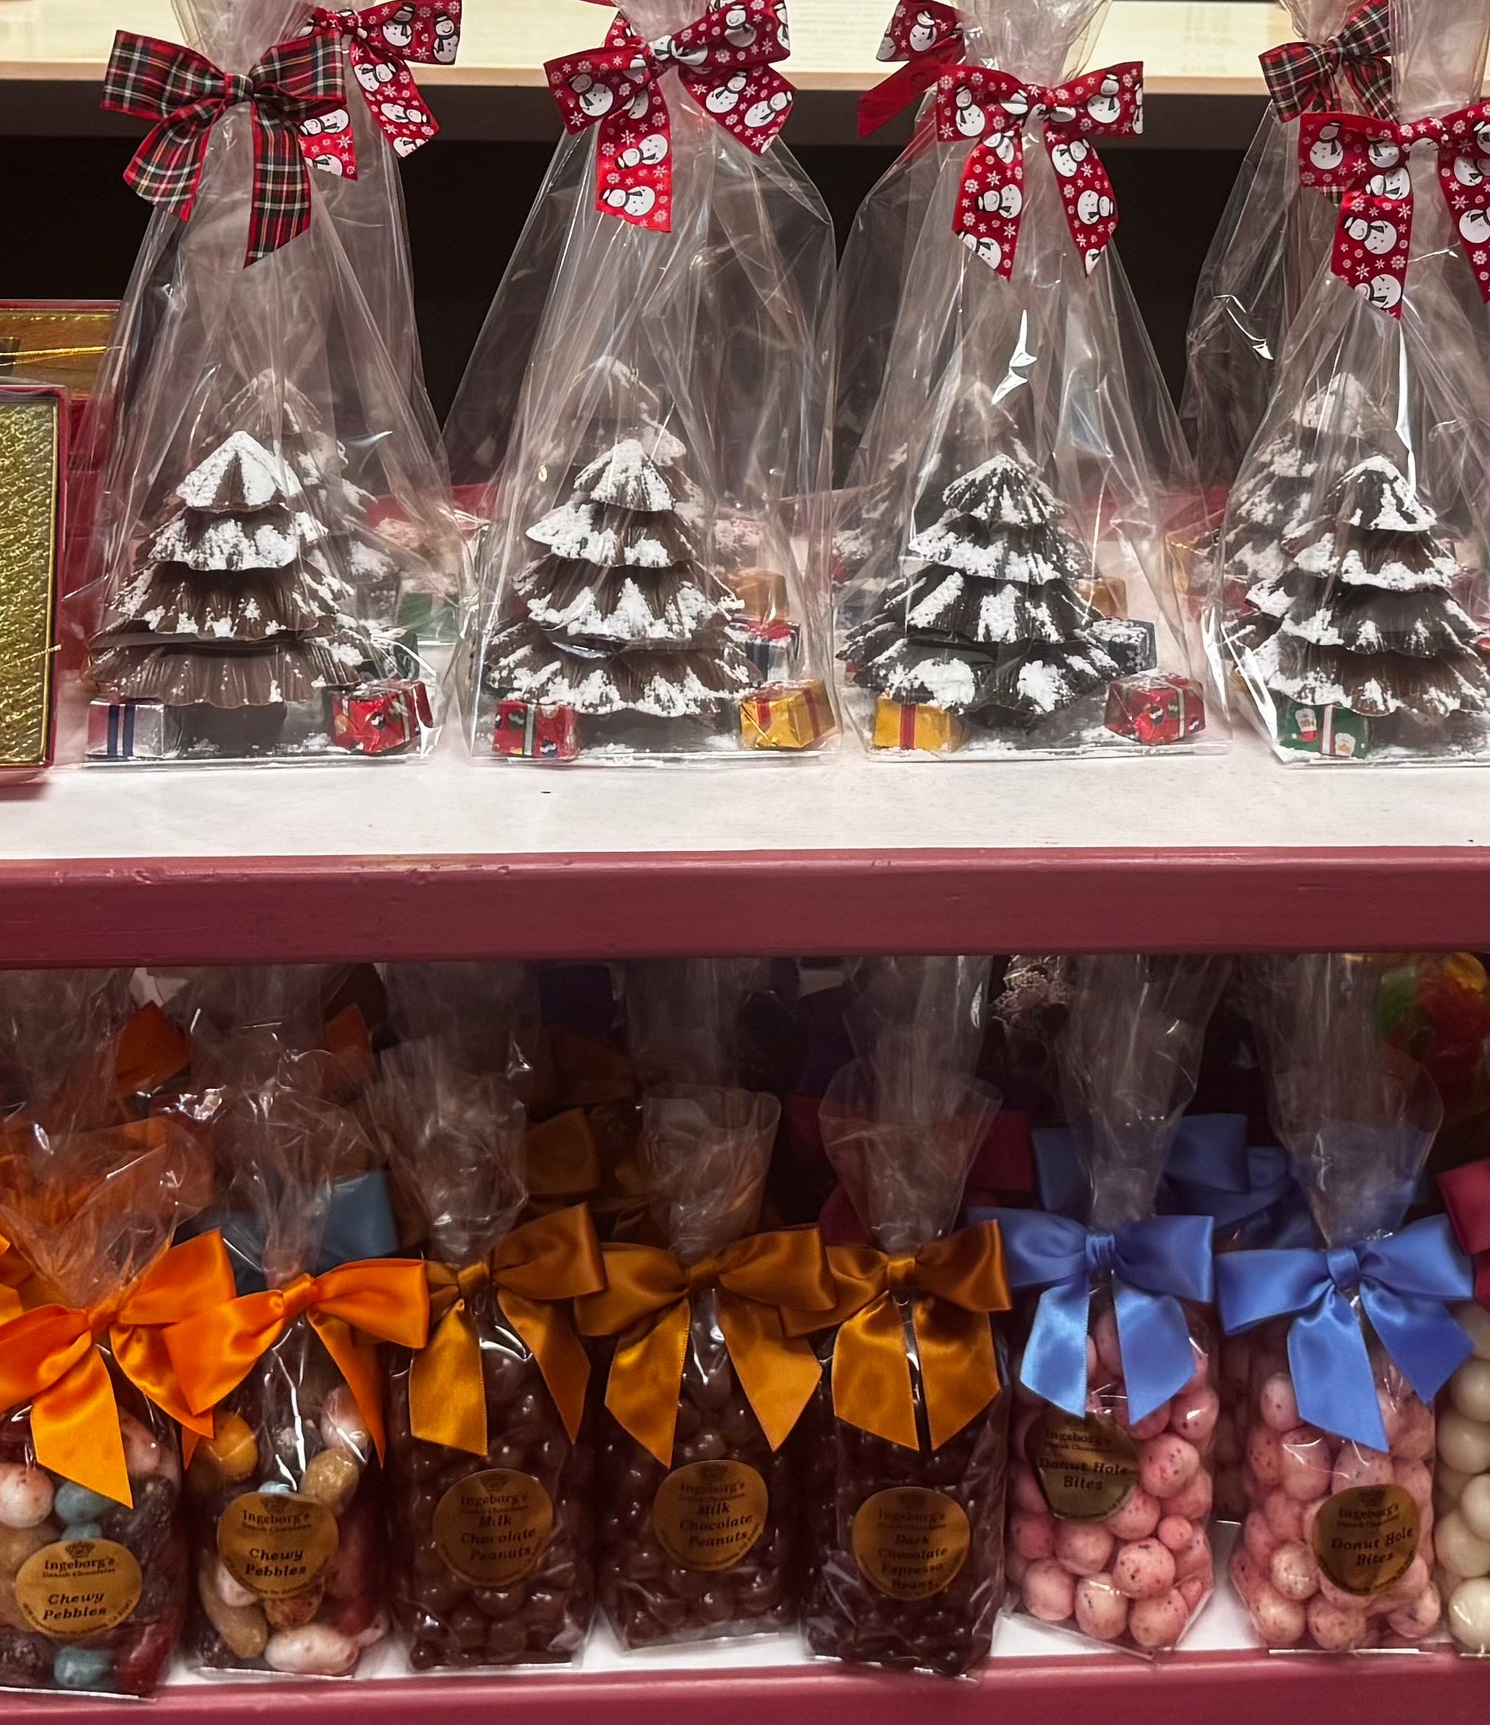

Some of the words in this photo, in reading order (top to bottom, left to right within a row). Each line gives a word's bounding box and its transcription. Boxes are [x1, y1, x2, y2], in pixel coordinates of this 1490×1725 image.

[1063, 1475, 1103, 1489] Bites
[697, 1502, 730, 1516] Milk
[242, 1509, 310, 1525] Ingeborg's
[679, 1514, 753, 1531] Chocolate
[688, 1531, 748, 1548] Peanuts
[1330, 1538, 1380, 1550] Donut
[1385, 1527, 1413, 1547] Hole
[249, 1548, 304, 1561] Chewy
[470, 1545, 531, 1561] Peanuts
[1356, 1552, 1394, 1566] Bites
[44, 1556, 116, 1572] Ingeborg's
[245, 1563, 307, 1577] Pebbles
[47, 1592, 104, 1605] Chewy
[43, 1606, 107, 1620] Pebbles
